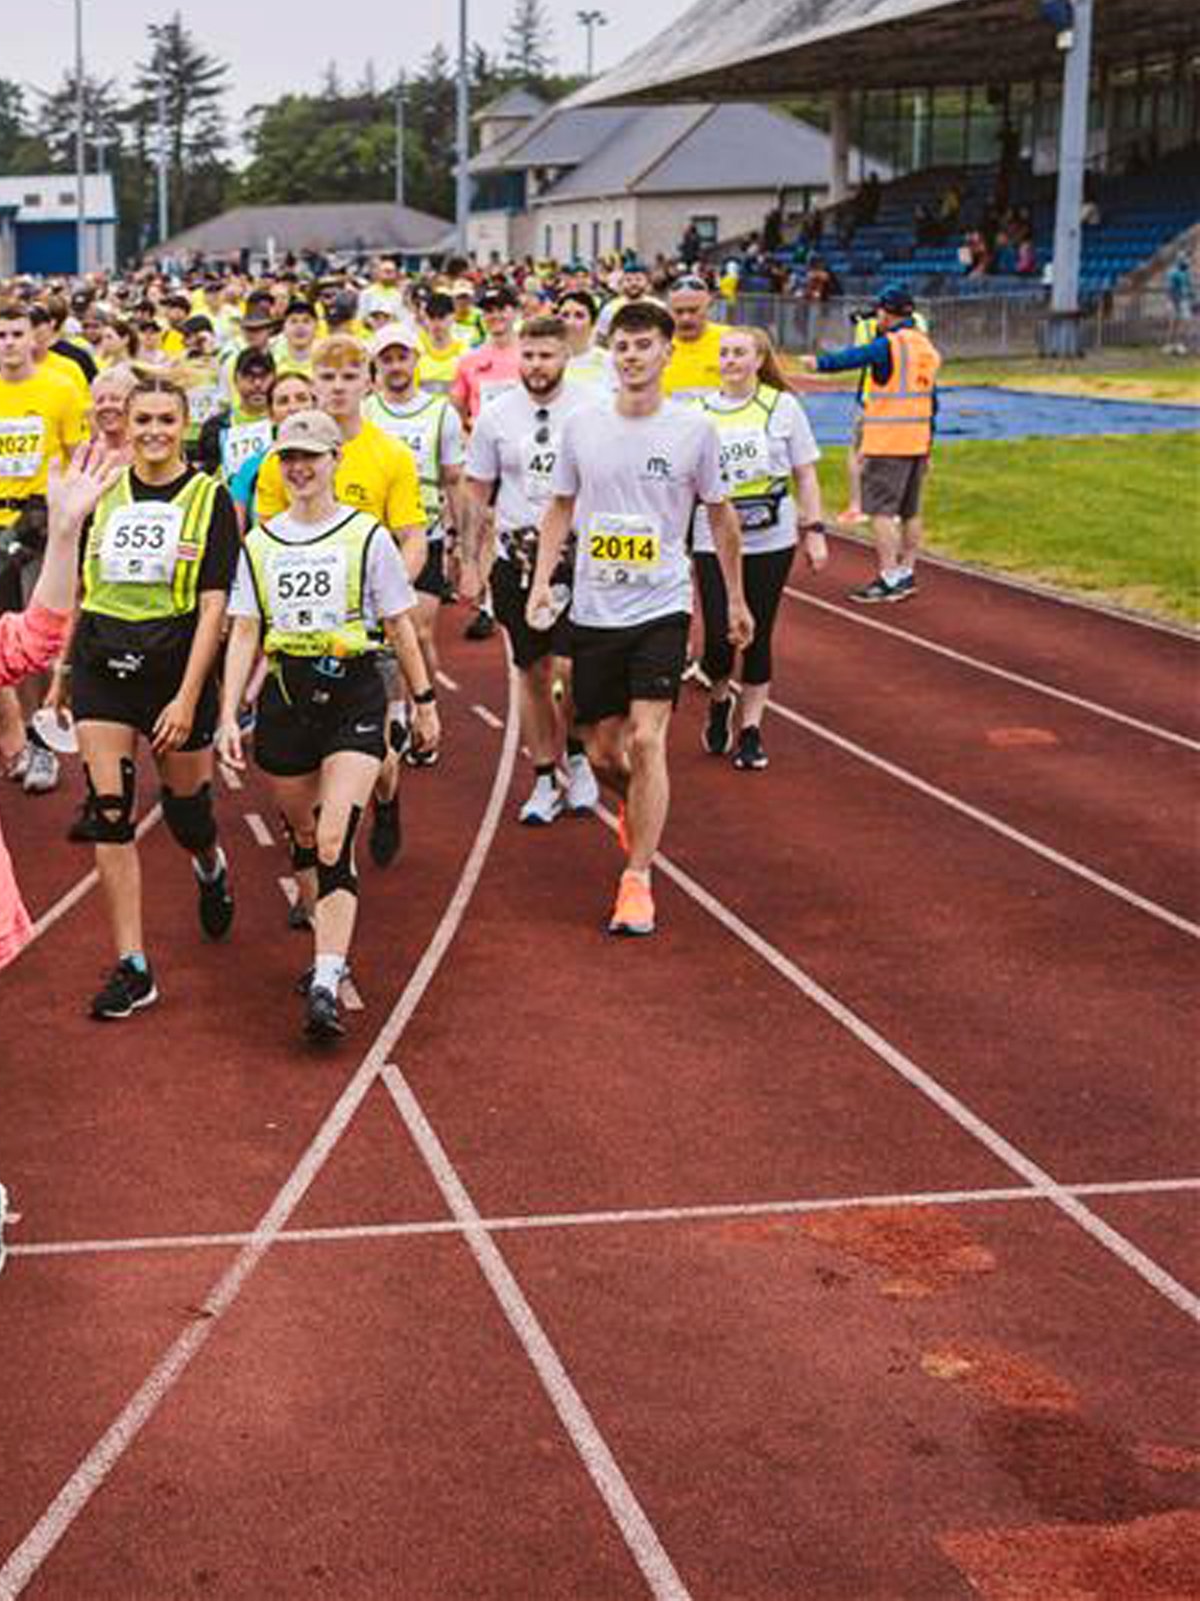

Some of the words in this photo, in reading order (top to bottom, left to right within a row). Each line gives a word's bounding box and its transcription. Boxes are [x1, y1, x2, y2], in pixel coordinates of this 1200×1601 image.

[113, 524, 166, 549] 553
[590, 535, 655, 561] 2014
[278, 570, 332, 600] 528
